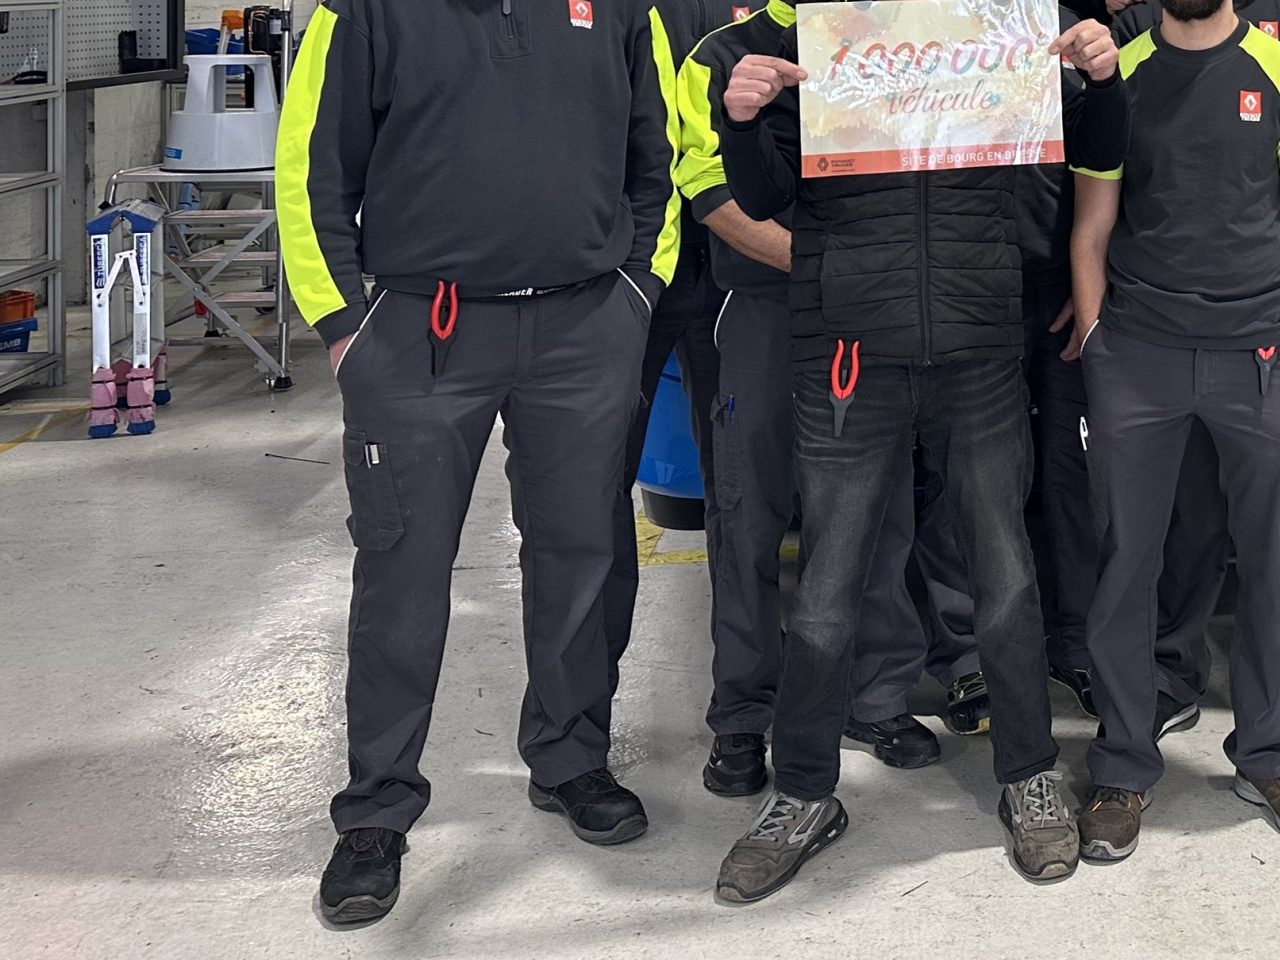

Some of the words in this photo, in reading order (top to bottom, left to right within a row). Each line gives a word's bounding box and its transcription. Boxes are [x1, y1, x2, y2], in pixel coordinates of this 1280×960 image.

[901, 155, 926, 167] SITE
[947, 152, 984, 163] BOURG
[987, 151, 1001, 161] EN
